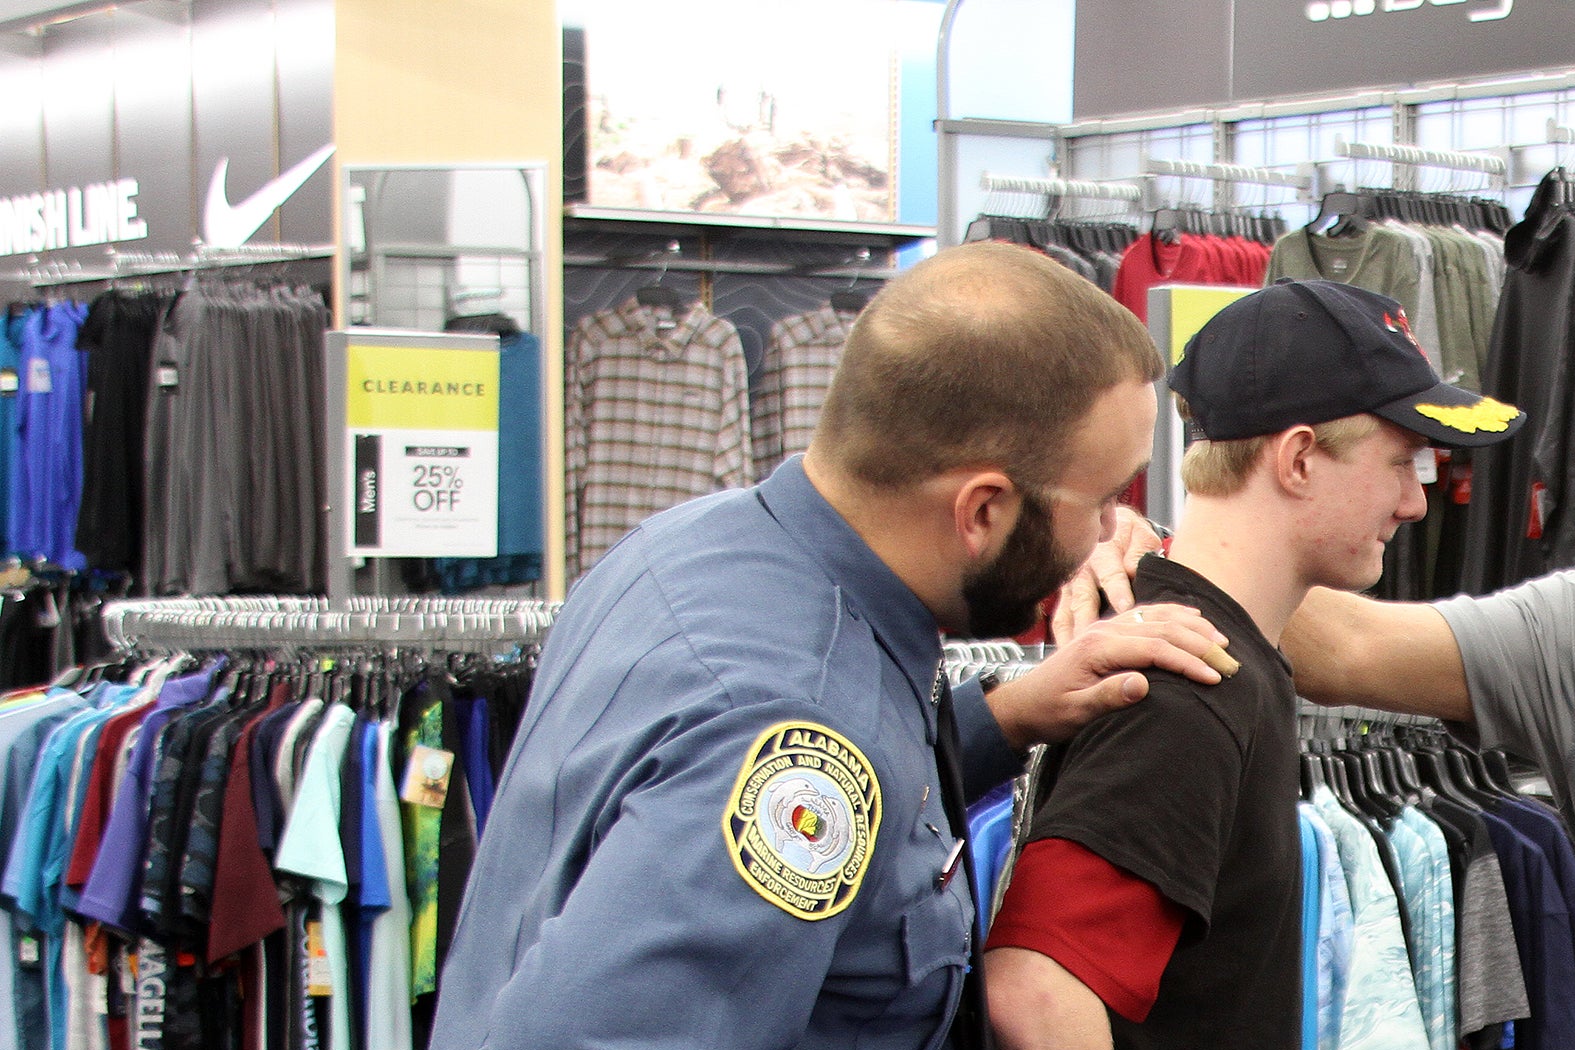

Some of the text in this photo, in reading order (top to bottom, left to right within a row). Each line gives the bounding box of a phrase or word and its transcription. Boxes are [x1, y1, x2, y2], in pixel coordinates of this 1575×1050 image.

[363, 379, 486, 397] CLEARANCE
[361, 468, 377, 514] Men's
[413, 465, 464, 488] 25%
[413, 489, 461, 511] OFF
[789, 731, 870, 791] ALABAMA
[740, 755, 868, 879] CONSERVATION AND NATURAL RESOURCES
[747, 825, 782, 874] MARINE
[782, 867, 836, 894] RESOURCES
[749, 863, 819, 911] ENFORCEMENT
